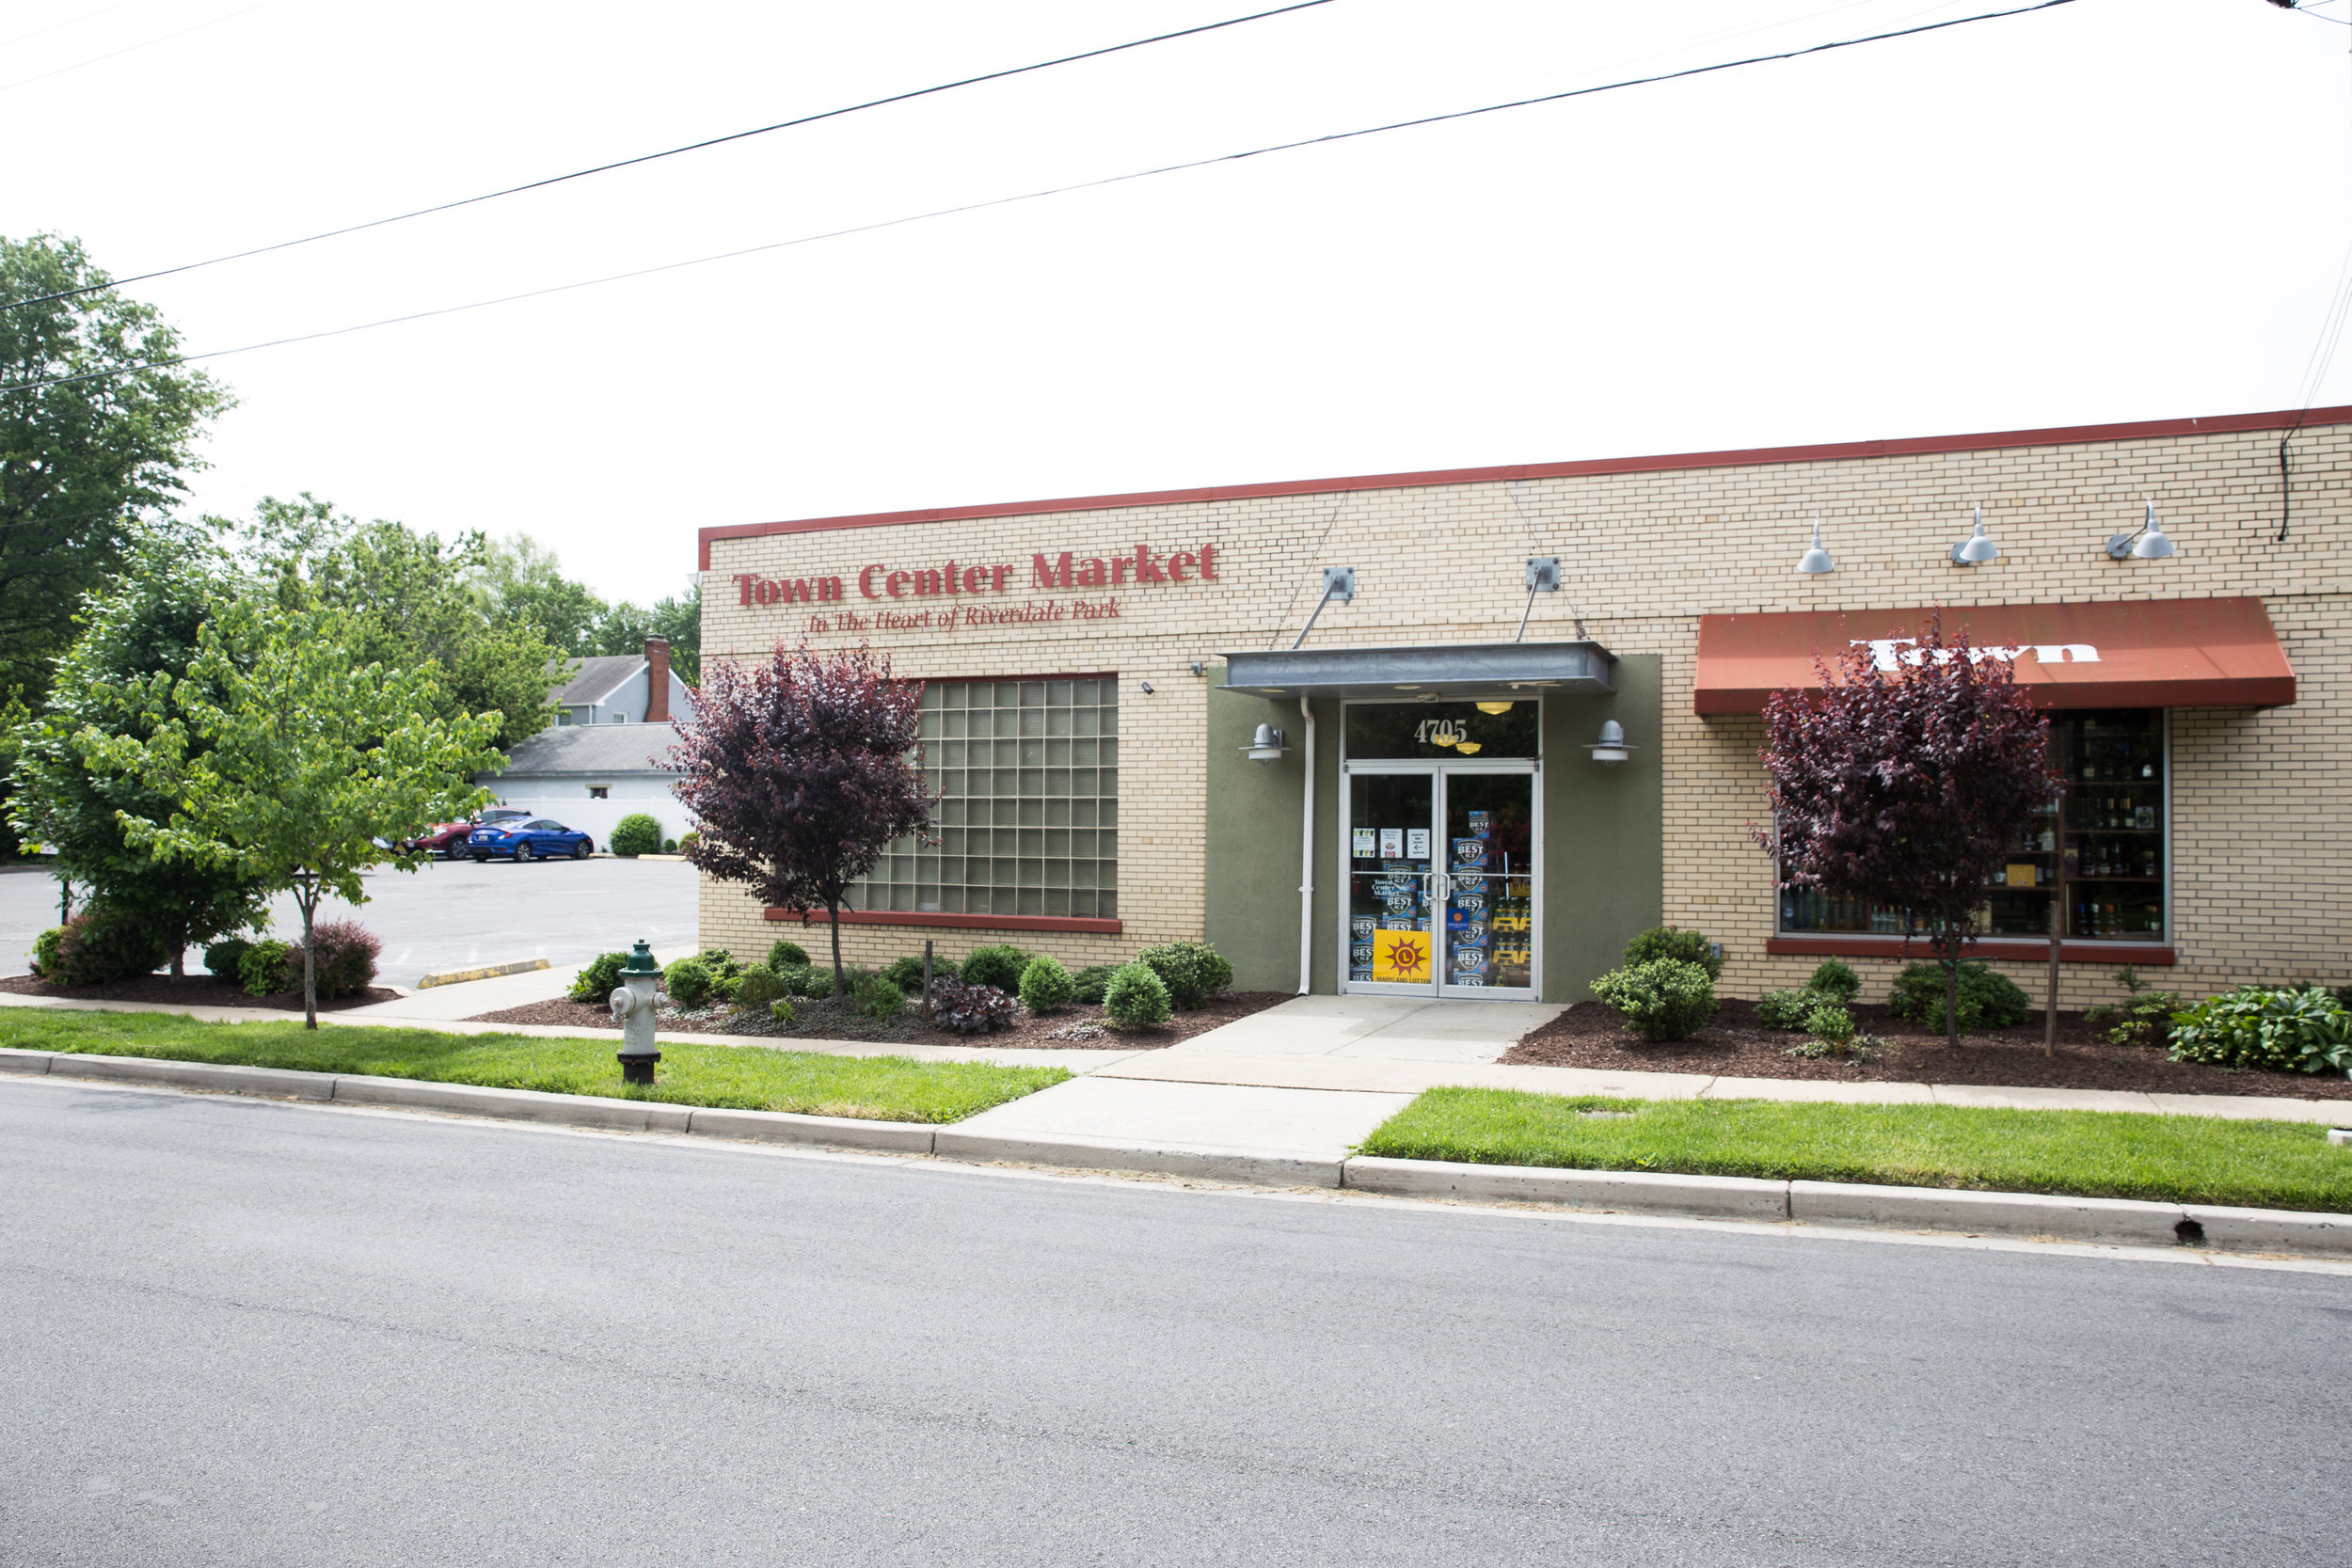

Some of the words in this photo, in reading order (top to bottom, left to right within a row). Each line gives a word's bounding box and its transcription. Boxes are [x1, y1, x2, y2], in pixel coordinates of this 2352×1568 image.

[732, 572, 843, 607] Town
[858, 559, 1014, 600] Center
[1030, 542, 1220, 590] Market
[808, 615, 828, 633] In
[834, 610, 868, 632] The
[875, 609, 931, 630] Heart
[937, 605, 961, 633] of
[964, 599, 1065, 626] Riverdale
[1072, 596, 1122, 620] Park
[1413, 719, 1467, 743] 4705
[1458, 846, 1485, 854] BEST
[1388, 897, 1412, 906] BEST
[1458, 899, 1484, 908] BEST
[1353, 922, 1377, 930] BEST
[1353, 948, 1374, 957] BES
[1458, 953, 1484, 961] BEST
